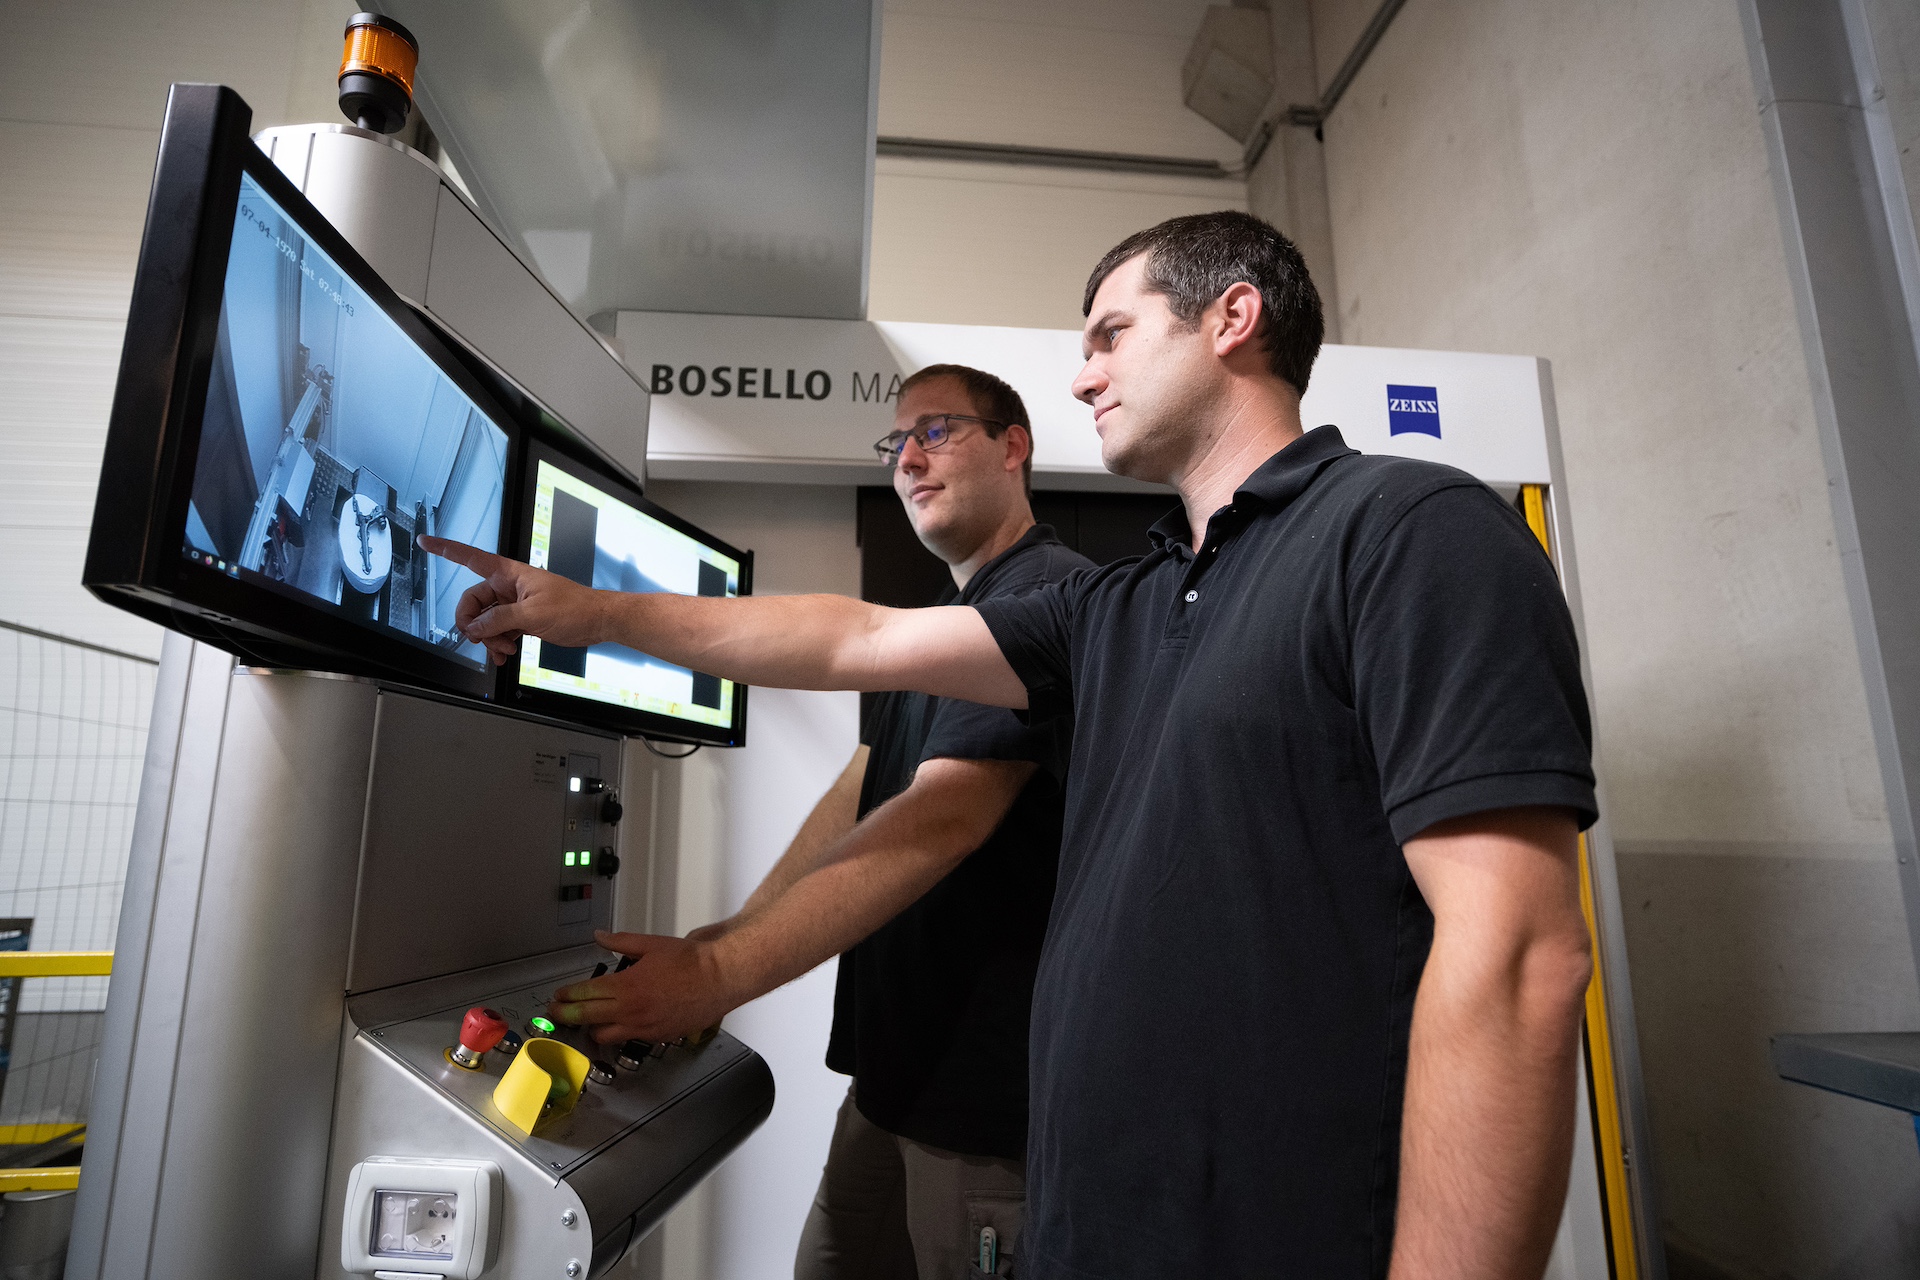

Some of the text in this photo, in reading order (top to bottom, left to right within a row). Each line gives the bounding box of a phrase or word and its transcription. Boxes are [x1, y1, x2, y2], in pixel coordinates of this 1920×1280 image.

[241, 204, 297, 262] 07-04-1970
[300, 259, 316, 281] Sat
[651, 364, 832, 401] BOSELLO
[1389, 398, 1437, 414] ZEISS
